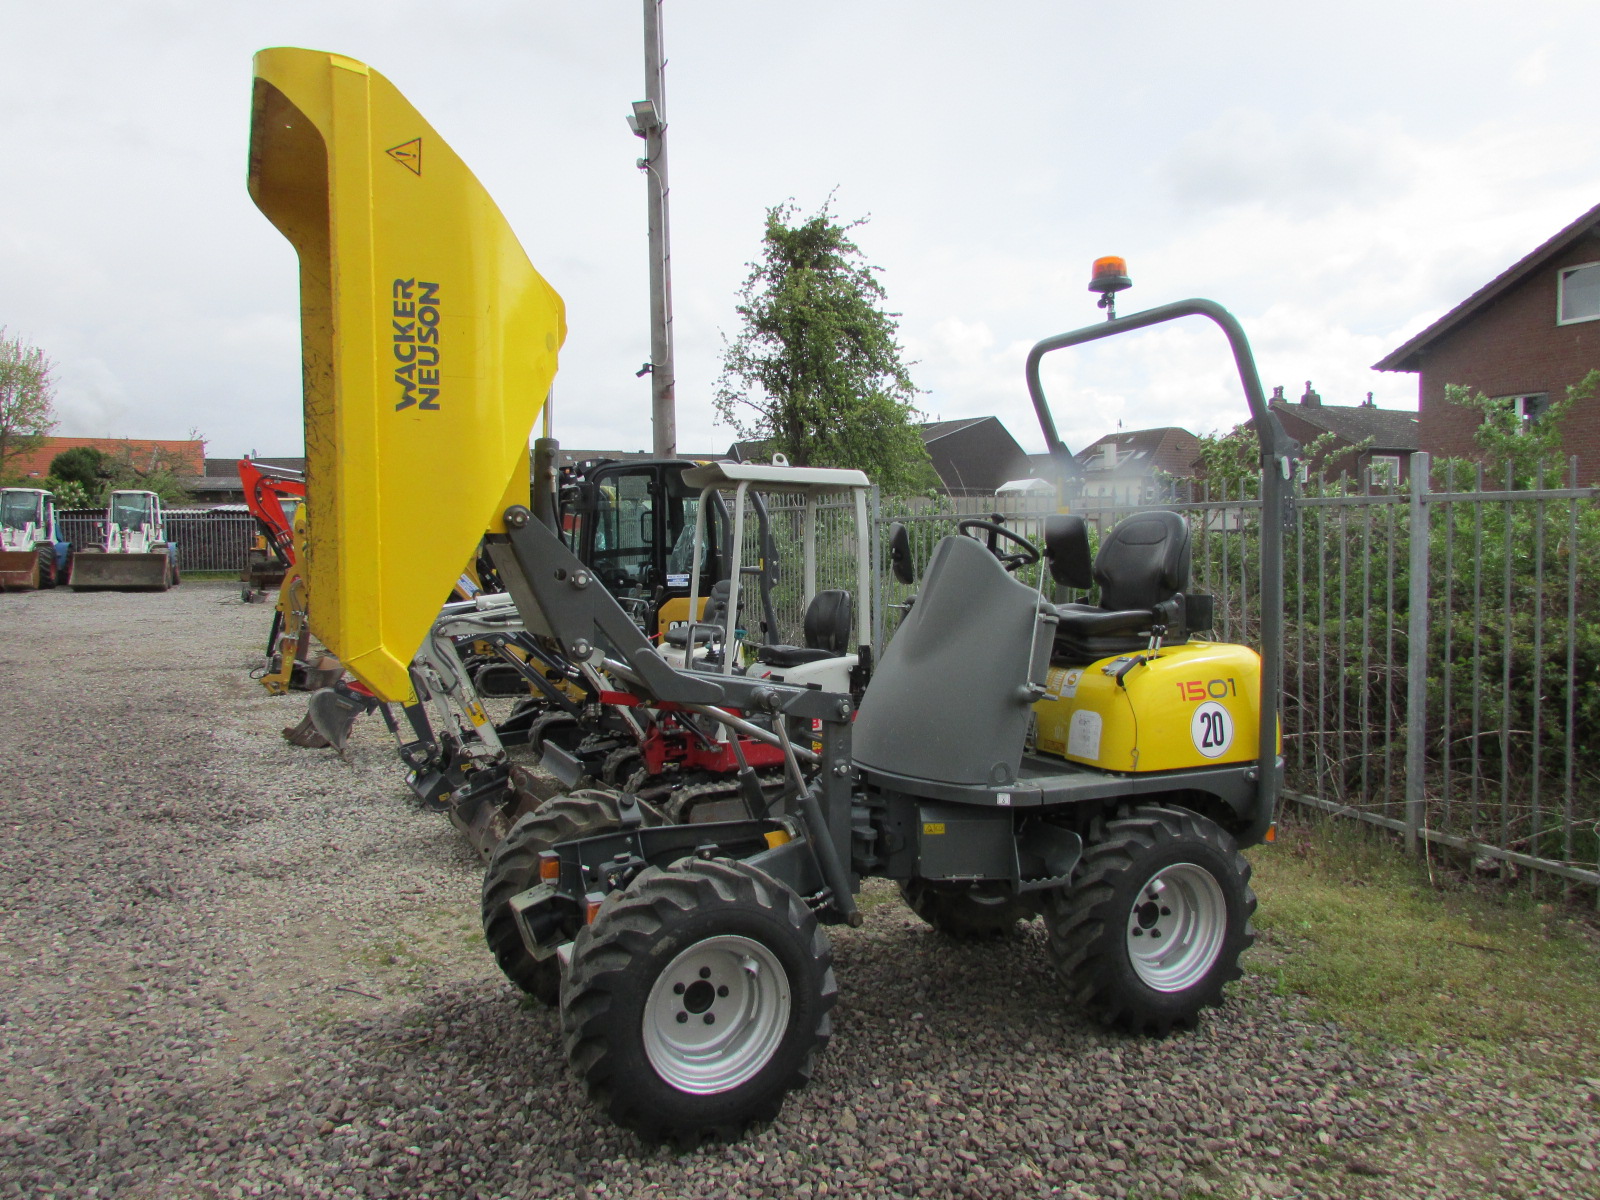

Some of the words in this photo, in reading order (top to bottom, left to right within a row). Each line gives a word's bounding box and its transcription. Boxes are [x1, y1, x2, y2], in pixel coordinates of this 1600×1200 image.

[393, 277, 417, 412] WACKER
[418, 281, 440, 411] NEUSON
[1176, 678, 1236, 701] 1501
[1200, 711, 1224, 748] 20
